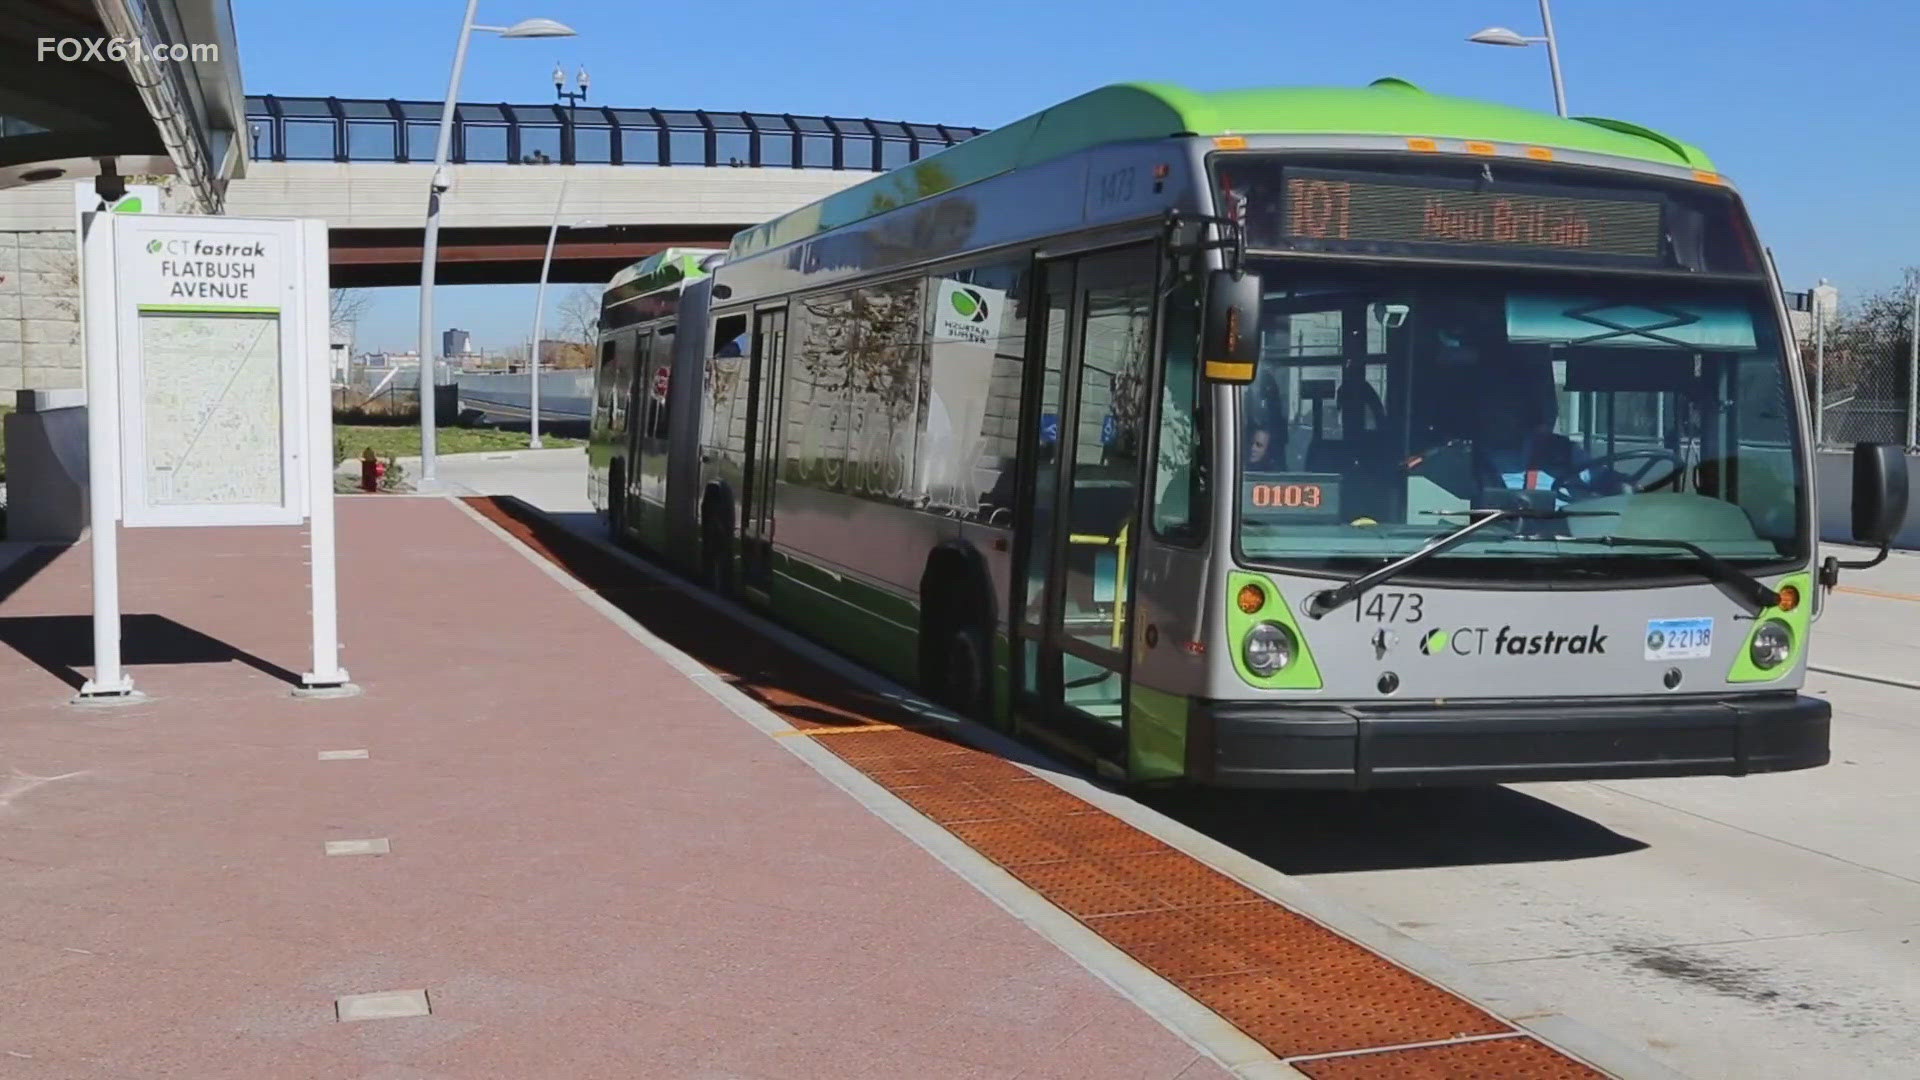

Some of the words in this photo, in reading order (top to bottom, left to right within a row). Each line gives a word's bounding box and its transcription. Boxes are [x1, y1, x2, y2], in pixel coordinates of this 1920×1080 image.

[167, 239, 190, 255] CT
[194, 239, 265, 257] fastrak
[161, 260, 255, 279] FLATBUSH
[170, 281, 249, 299] AVENUE
[1252, 484, 1321, 508] 0103
[1356, 593, 1424, 623] 1473
[1452, 627, 1489, 656] CT
[1495, 625, 1608, 655] fastrak
